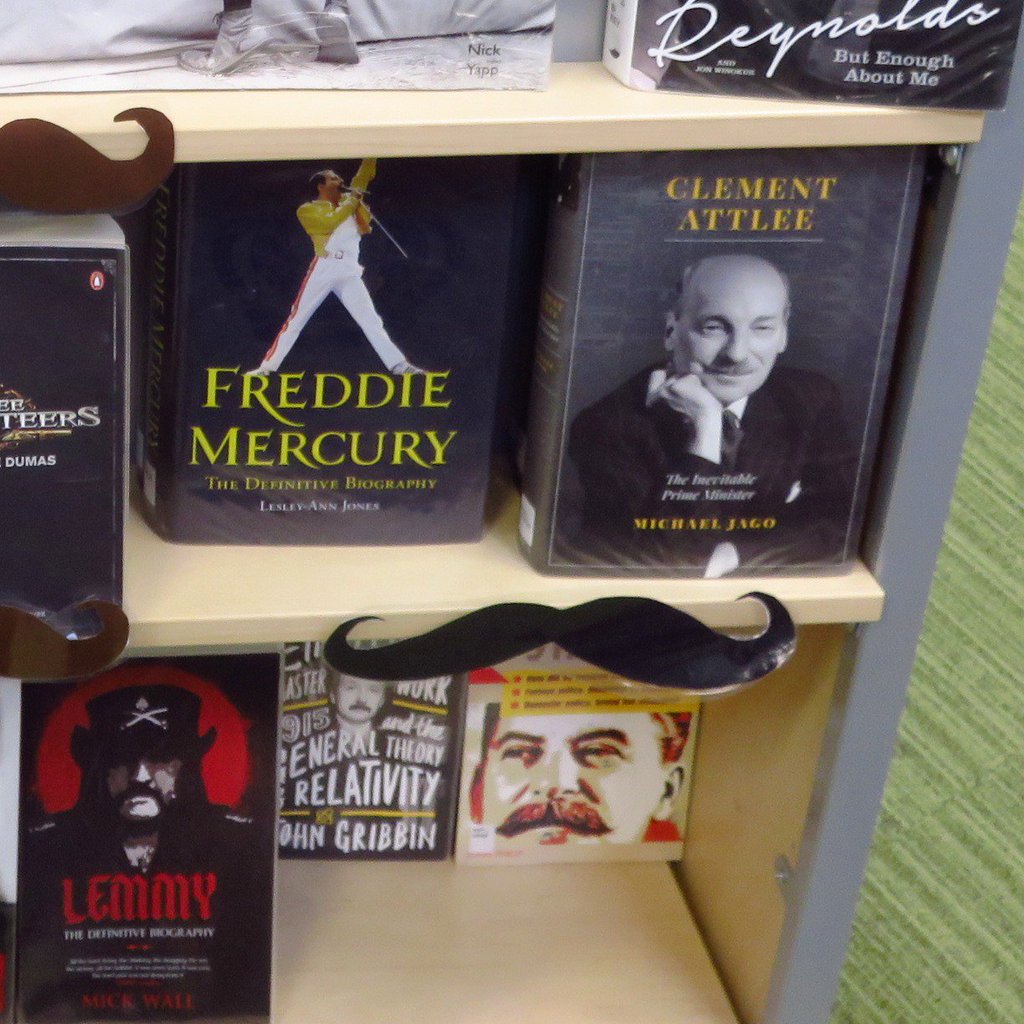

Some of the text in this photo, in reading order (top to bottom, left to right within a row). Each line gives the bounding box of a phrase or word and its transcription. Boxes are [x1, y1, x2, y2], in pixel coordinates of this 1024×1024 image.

[468, 44, 500, 56] Nick
[833, 48, 954, 69] But Enough
[467, 63, 499, 78] Yapp
[844, 70, 940, 87] About Me
[665, 176, 838, 200] CLEMENT
[678, 208, 814, 231] ATTLEE
[201, 365, 453, 427] FREDDIE
[188, 427, 458, 469] MERCURY
[5, 455, 57, 468] DUMAS
[205, 477, 239, 490] THE
[666, 473, 758, 486] The Inevitable
[661, 489, 755, 501] Prime Minister
[633, 518, 777, 531] MICHAEL JAGO
[386, 736, 446, 767] THEORY
[295, 760, 442, 807] RELATIVITY
[334, 820, 438, 853] GRIBBIN
[64, 928, 215, 941] THE DEFINITIVE BIOGRAPHY
[82, 993, 193, 1009] MICK WALL
